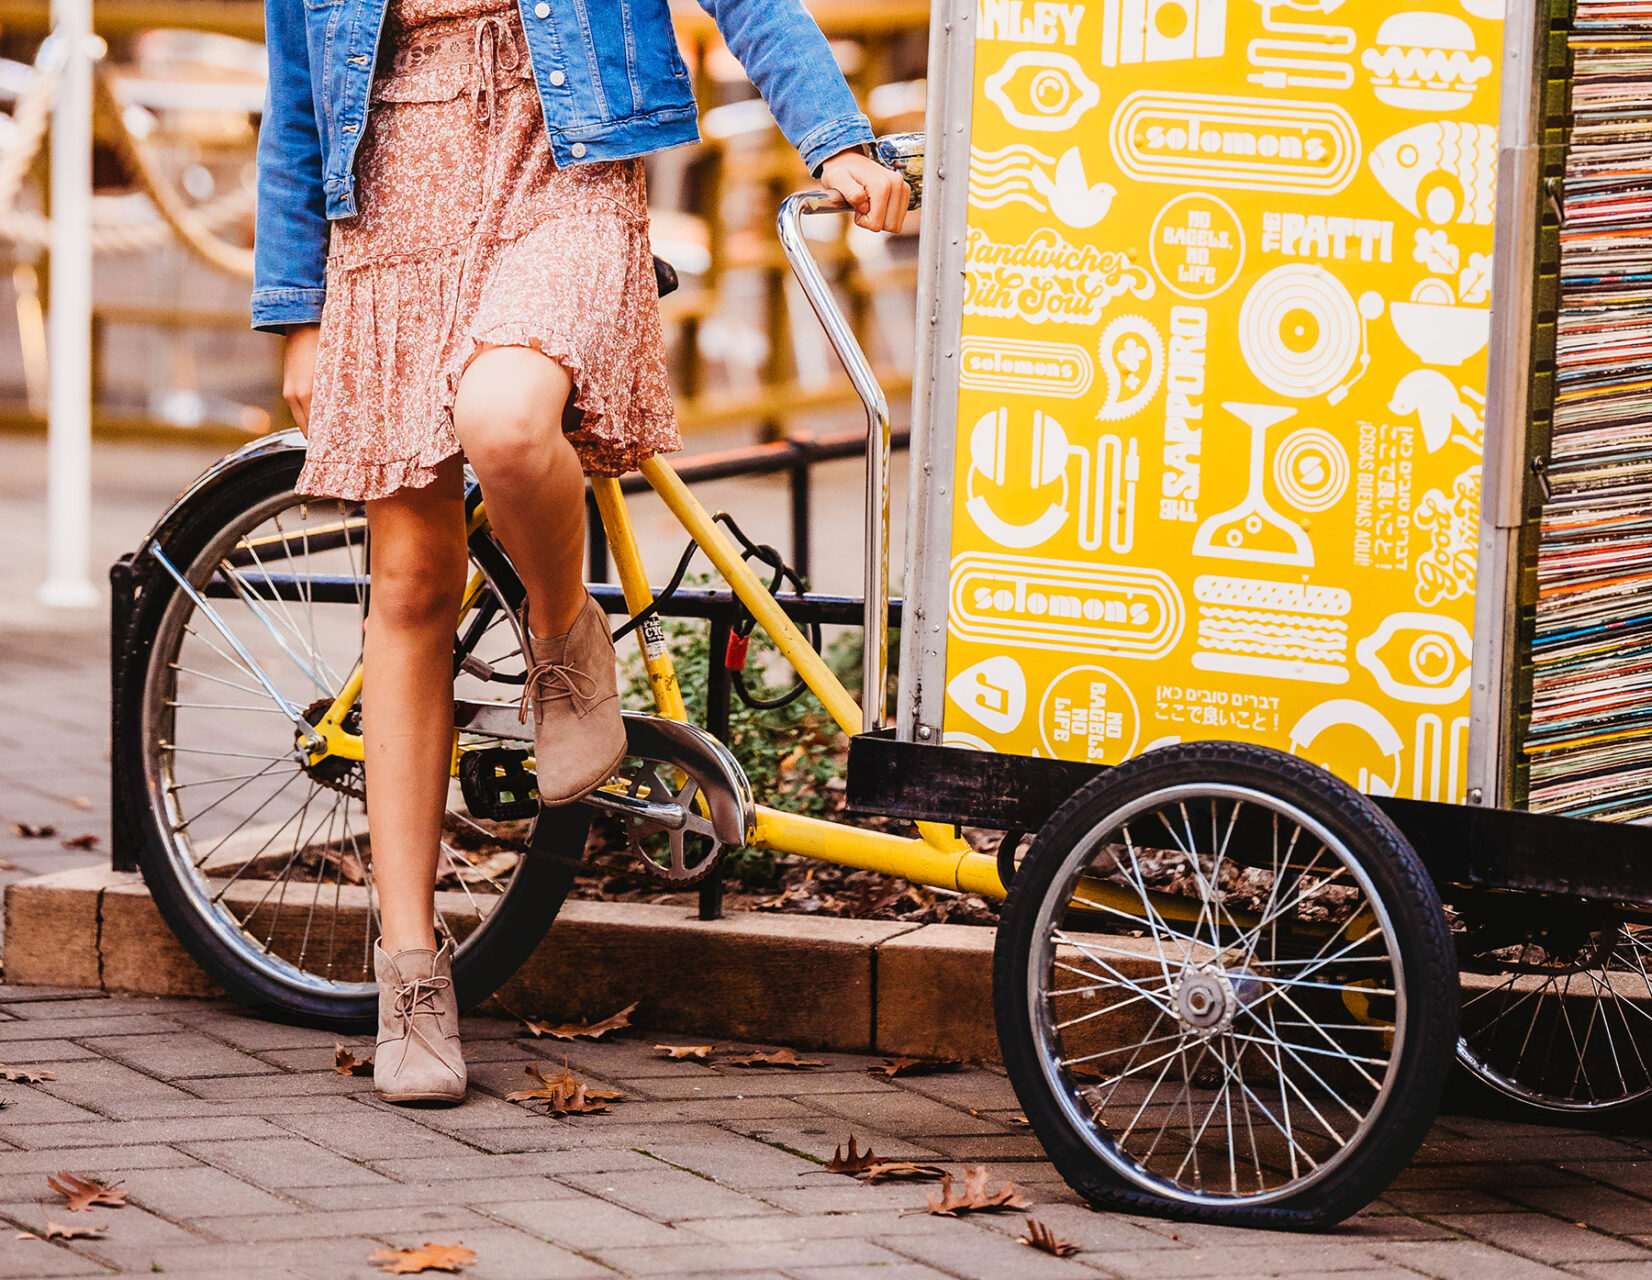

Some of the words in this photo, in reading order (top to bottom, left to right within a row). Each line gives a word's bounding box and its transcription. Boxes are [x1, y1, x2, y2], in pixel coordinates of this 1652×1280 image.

[1146, 119, 1330, 161] solomon's
[1188, 210, 1211, 229] NO
[1262, 211, 1281, 253] THE
[1281, 213, 1394, 263] PATTI
[1178, 264, 1216, 284] LIFE
[1186, 247, 1210, 265] NO
[1017, 273, 1104, 316] Soul
[970, 353, 1073, 378] solomon's
[1162, 305, 1208, 500] SAPPORO
[1355, 473, 1374, 527] BUENAS
[1417, 497, 1458, 603] Good
[973, 581, 1149, 625] solomon's
[1053, 697, 1071, 742] LIFE
[1071, 708, 1088, 735] NO
[1106, 712, 1123, 738] NO
